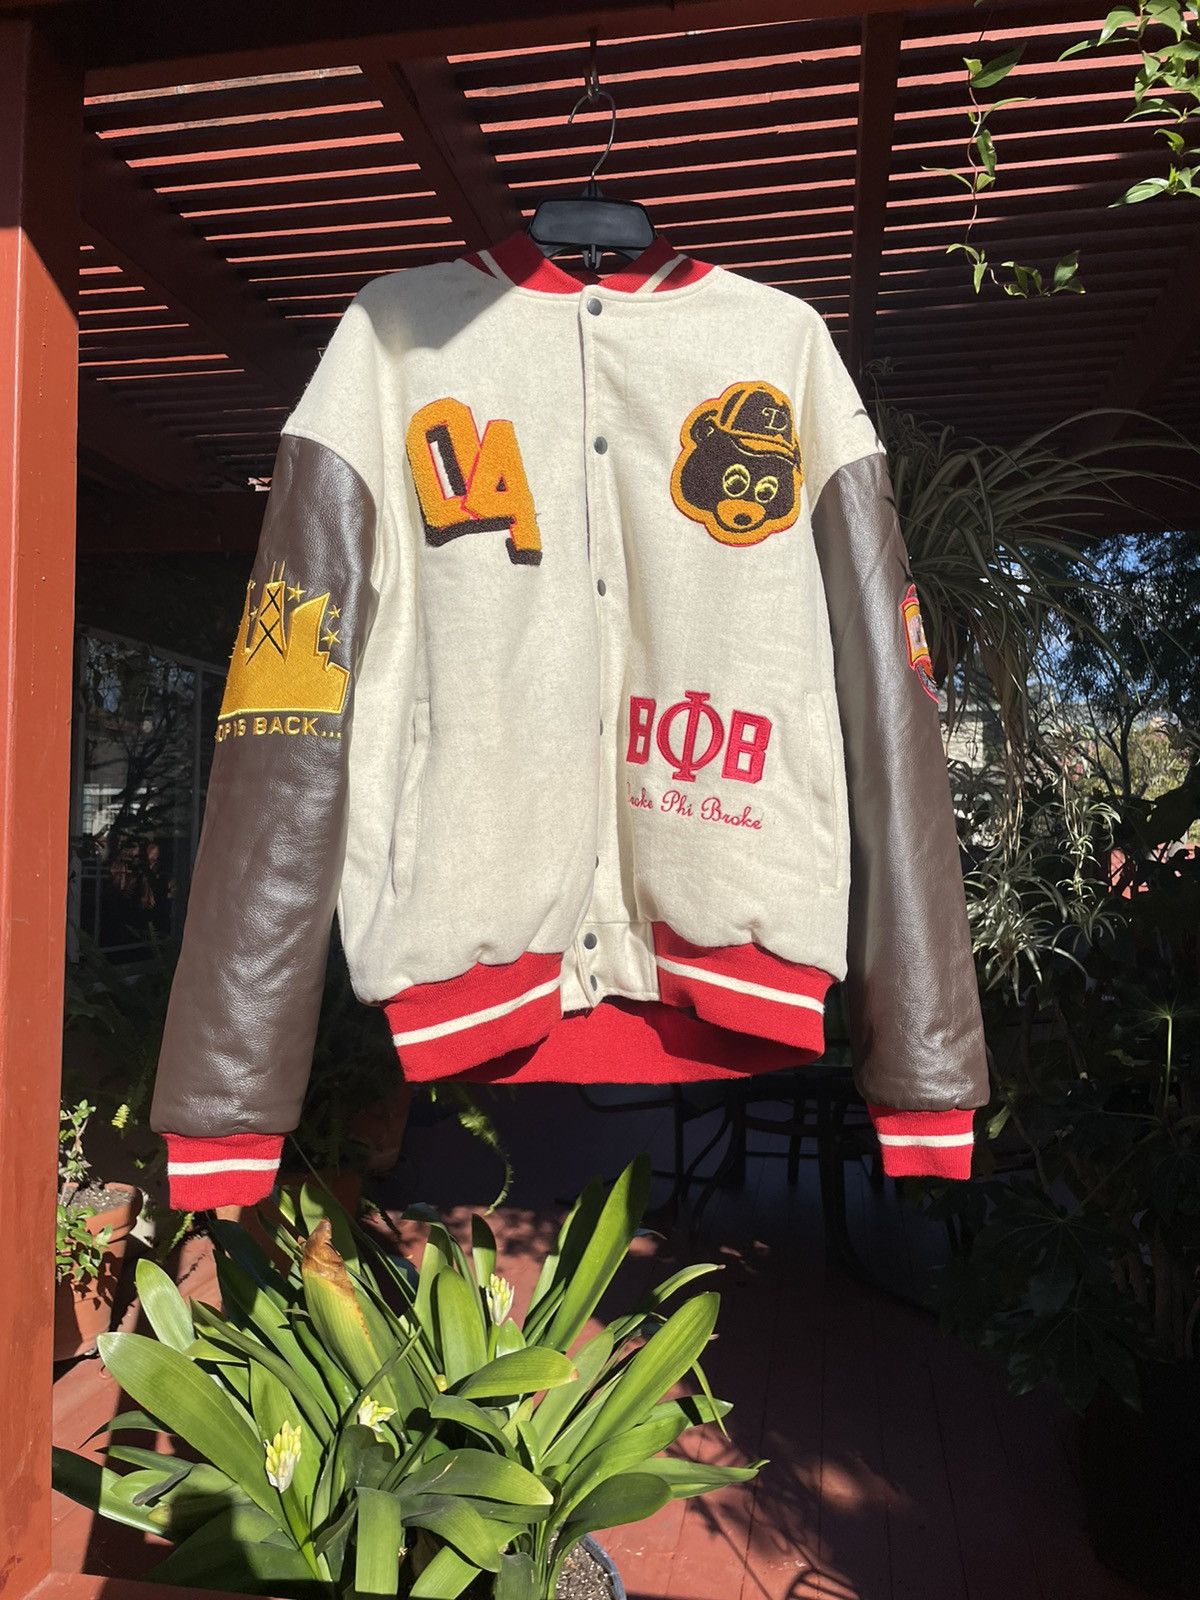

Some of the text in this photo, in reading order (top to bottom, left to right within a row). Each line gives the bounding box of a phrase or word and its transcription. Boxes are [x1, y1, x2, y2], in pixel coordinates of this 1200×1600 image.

[252, 716, 342, 739] BACK...
[626, 781, 762, 830] roke Phi Broke
